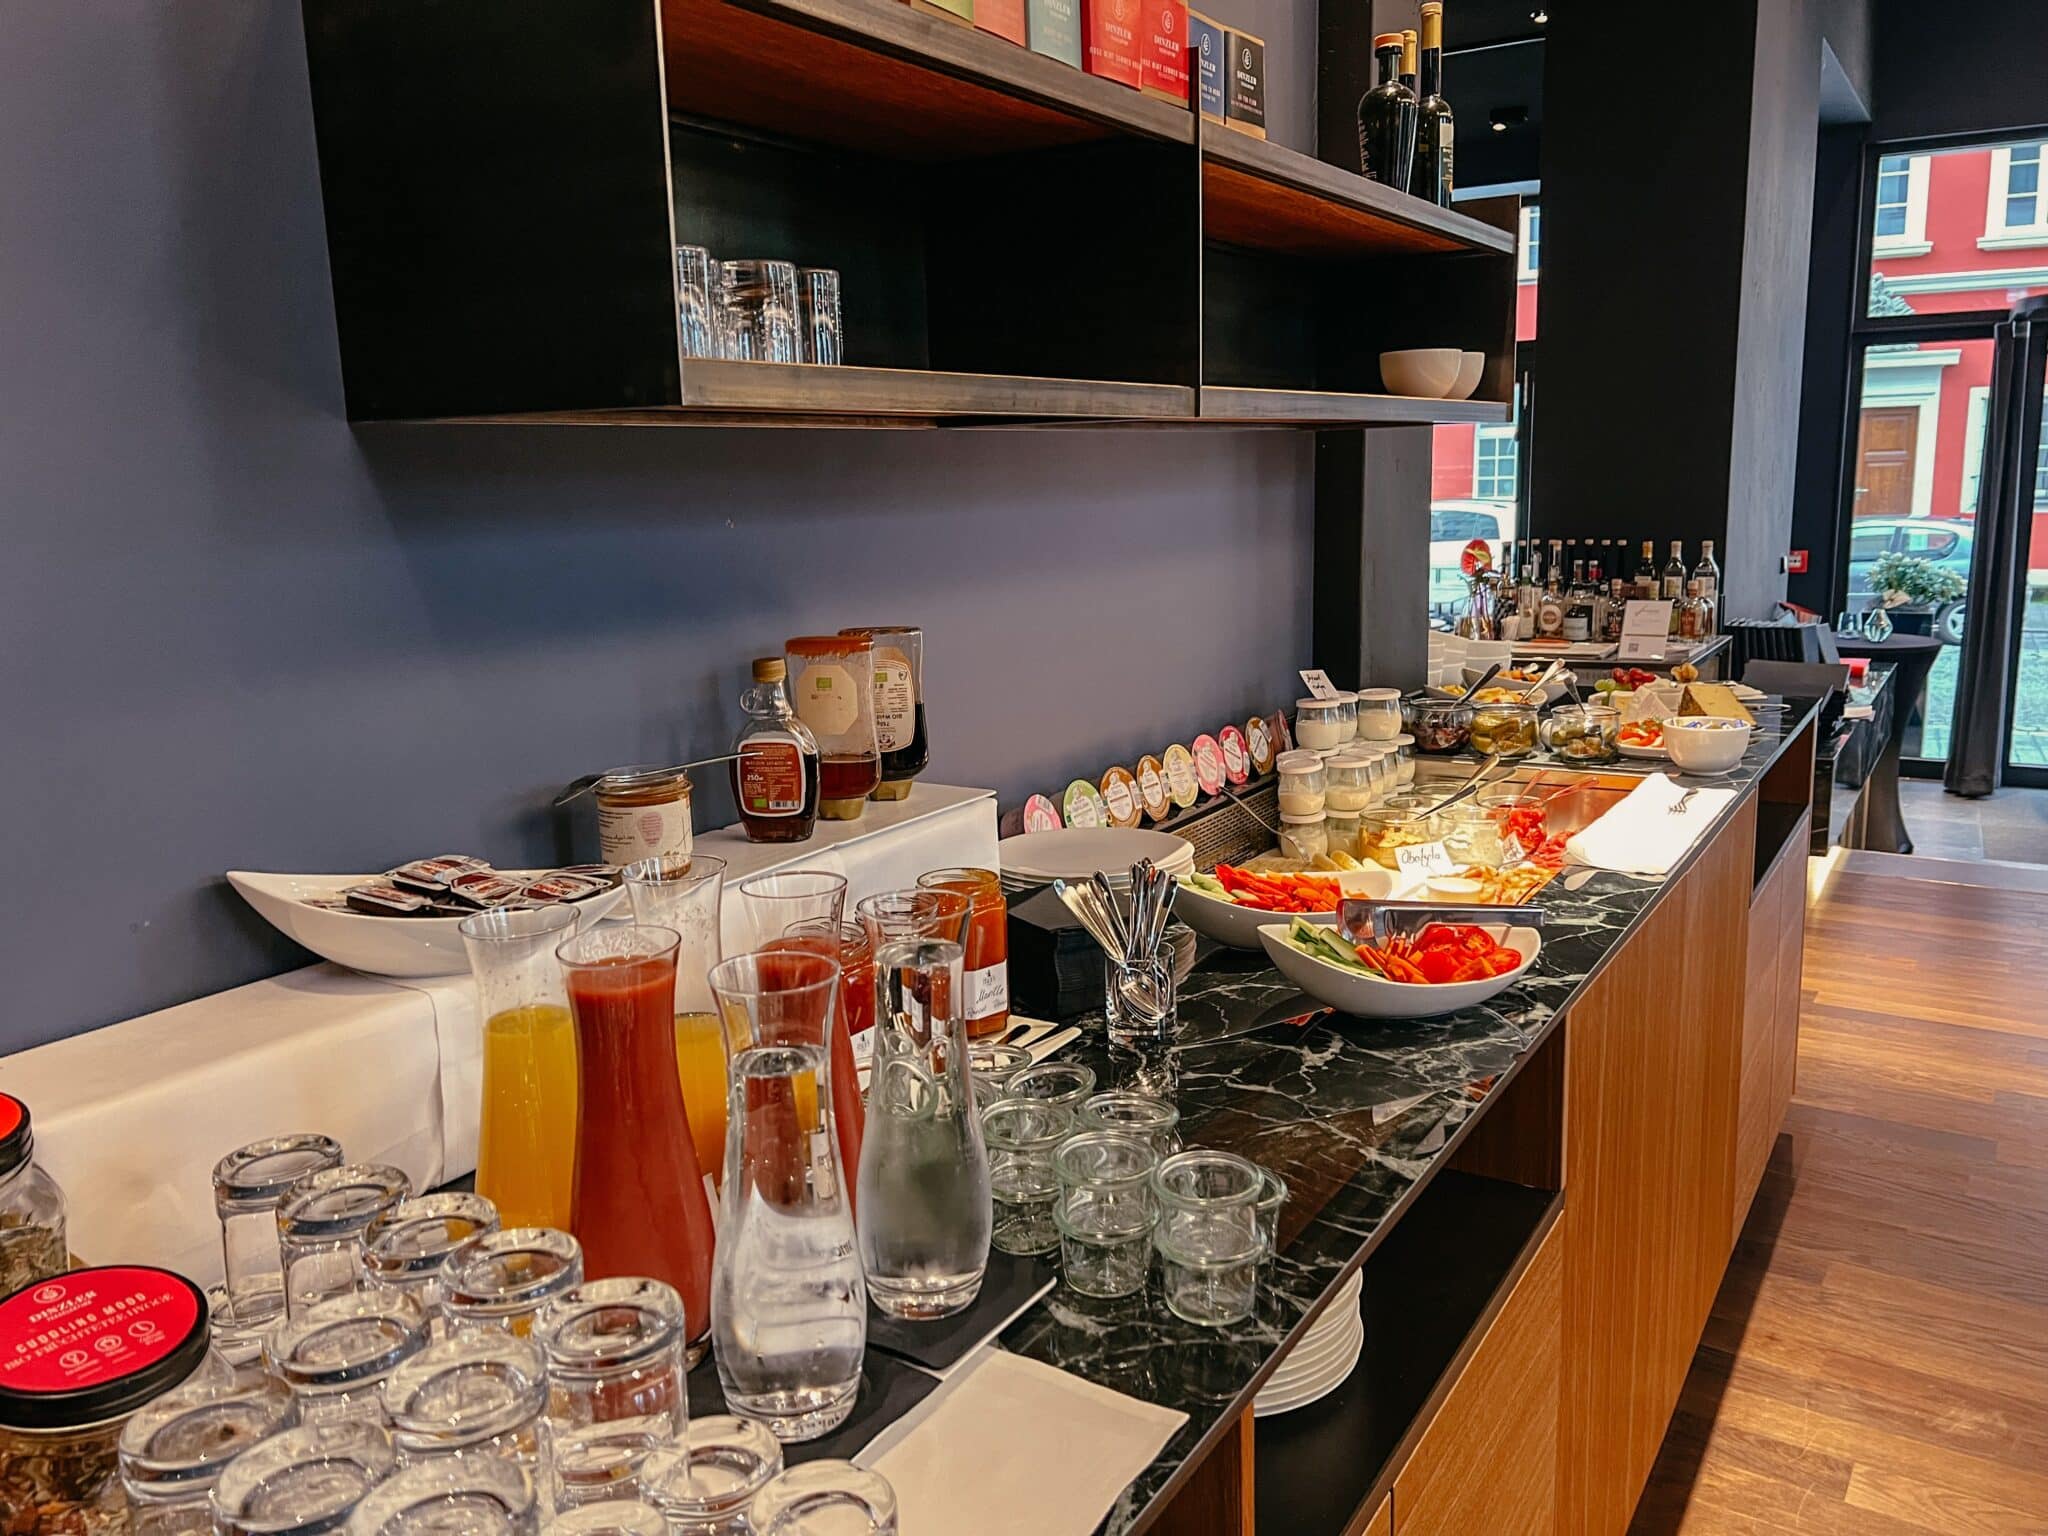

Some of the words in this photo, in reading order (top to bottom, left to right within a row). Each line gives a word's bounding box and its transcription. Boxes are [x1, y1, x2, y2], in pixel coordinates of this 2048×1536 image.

[1105, 22, 1132, 41] DINZLER
[1153, 34, 1180, 52] DINZLER
[102, 1292, 146, 1316] MOOD
